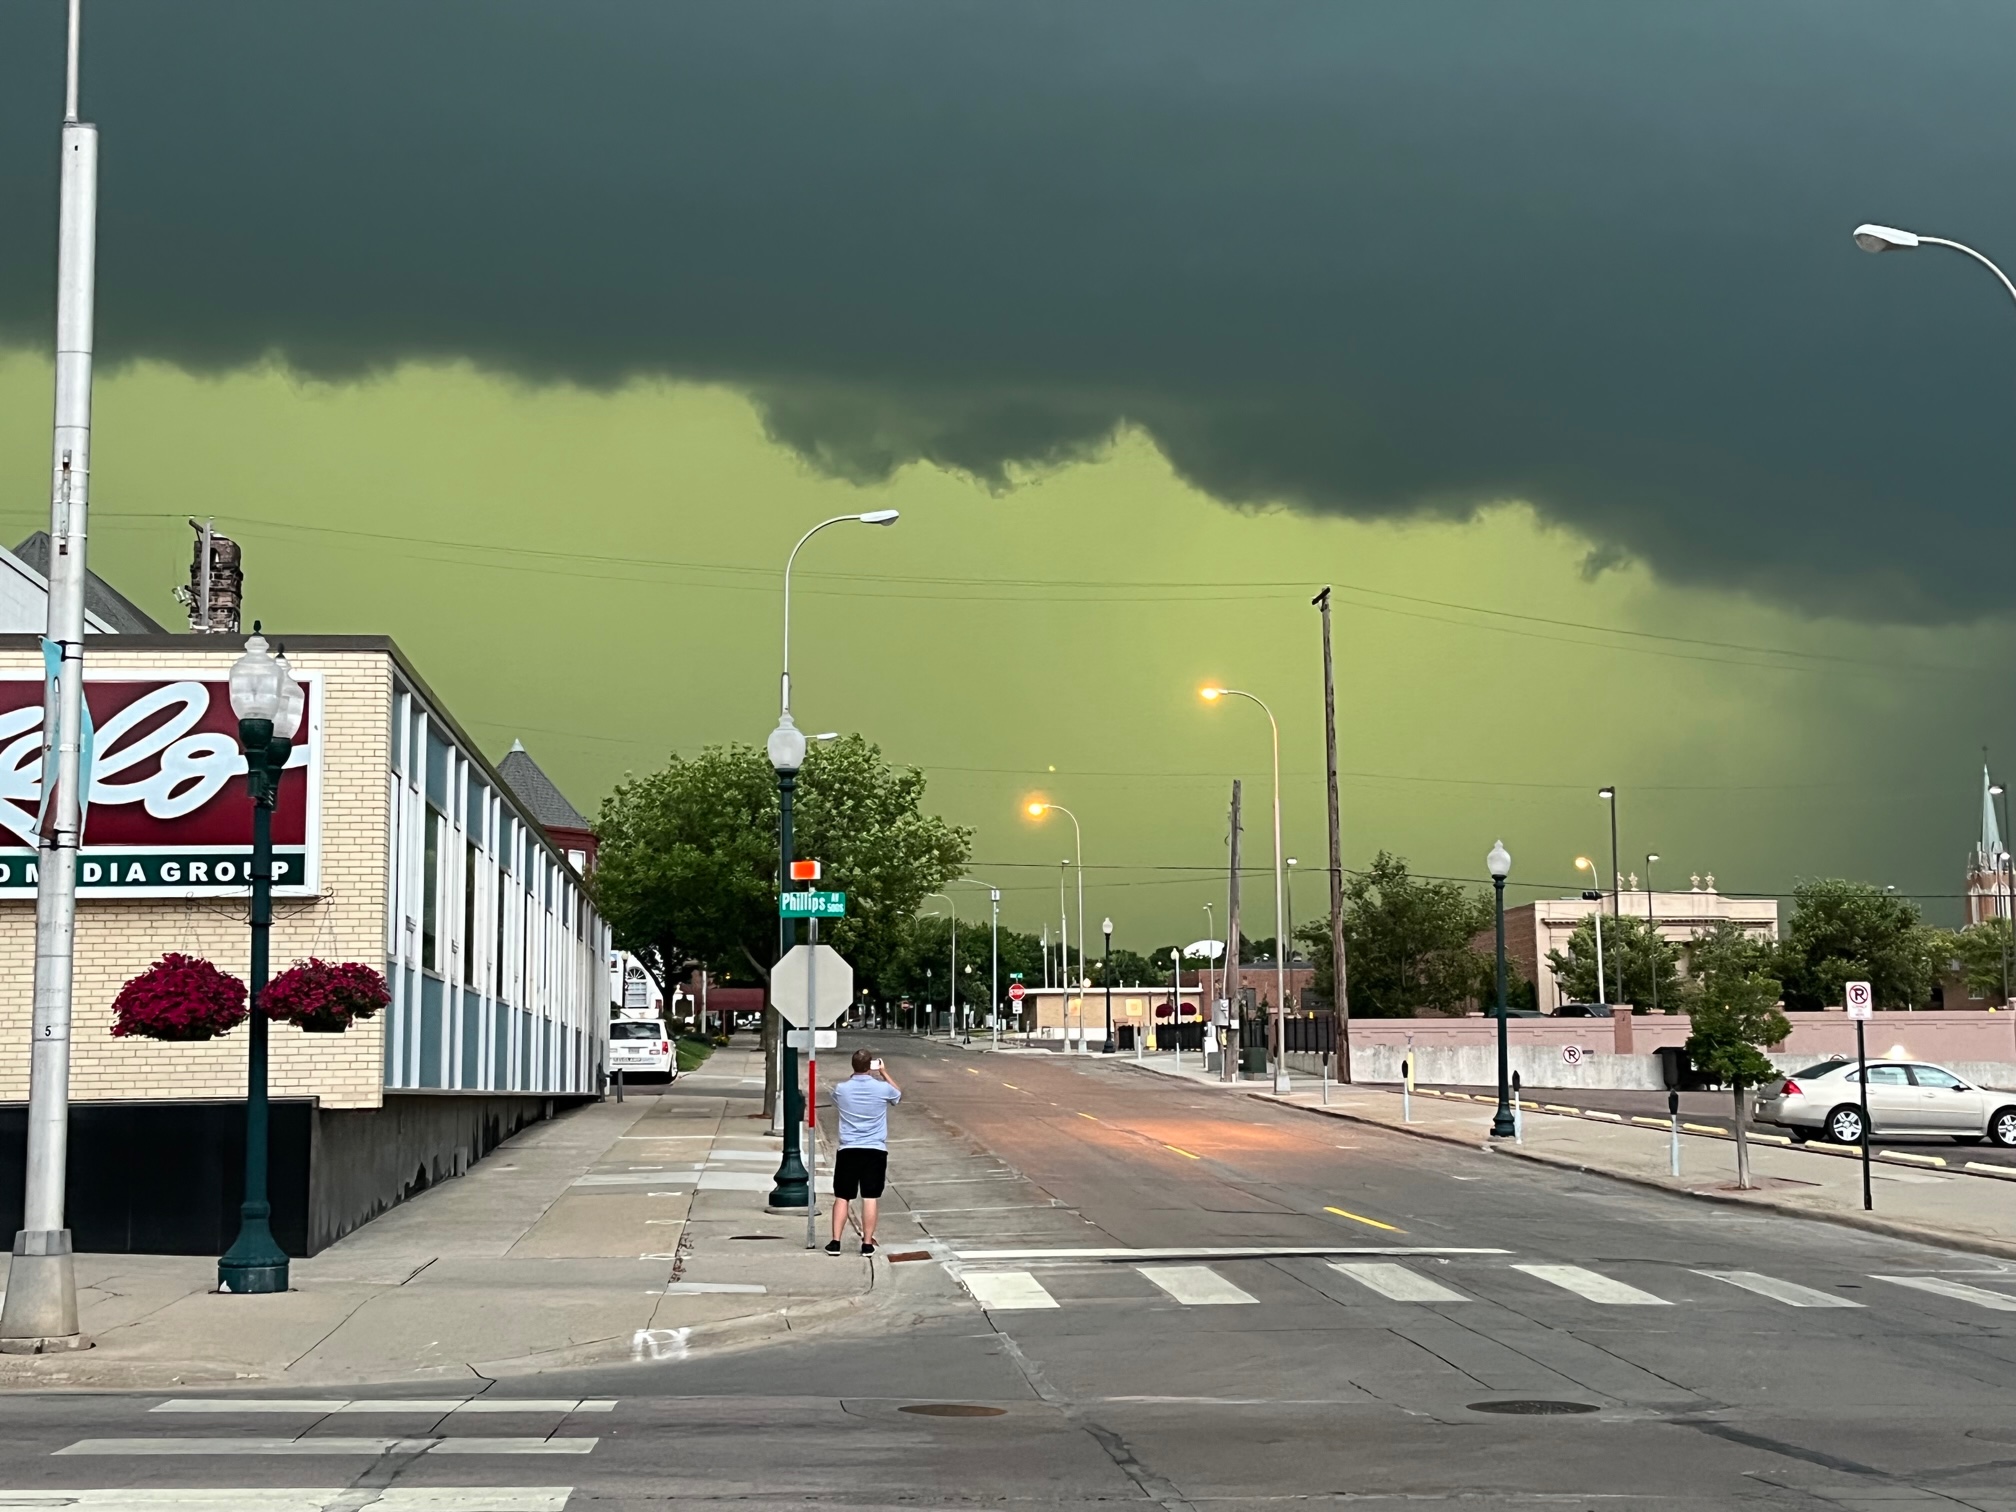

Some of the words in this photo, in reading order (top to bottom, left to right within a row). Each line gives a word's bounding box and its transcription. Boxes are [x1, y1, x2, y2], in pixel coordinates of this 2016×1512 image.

[25, 862, 147, 883] MDIA
[782, 892, 826, 913] Phillips
[45, 1026, 52, 1037] 5
